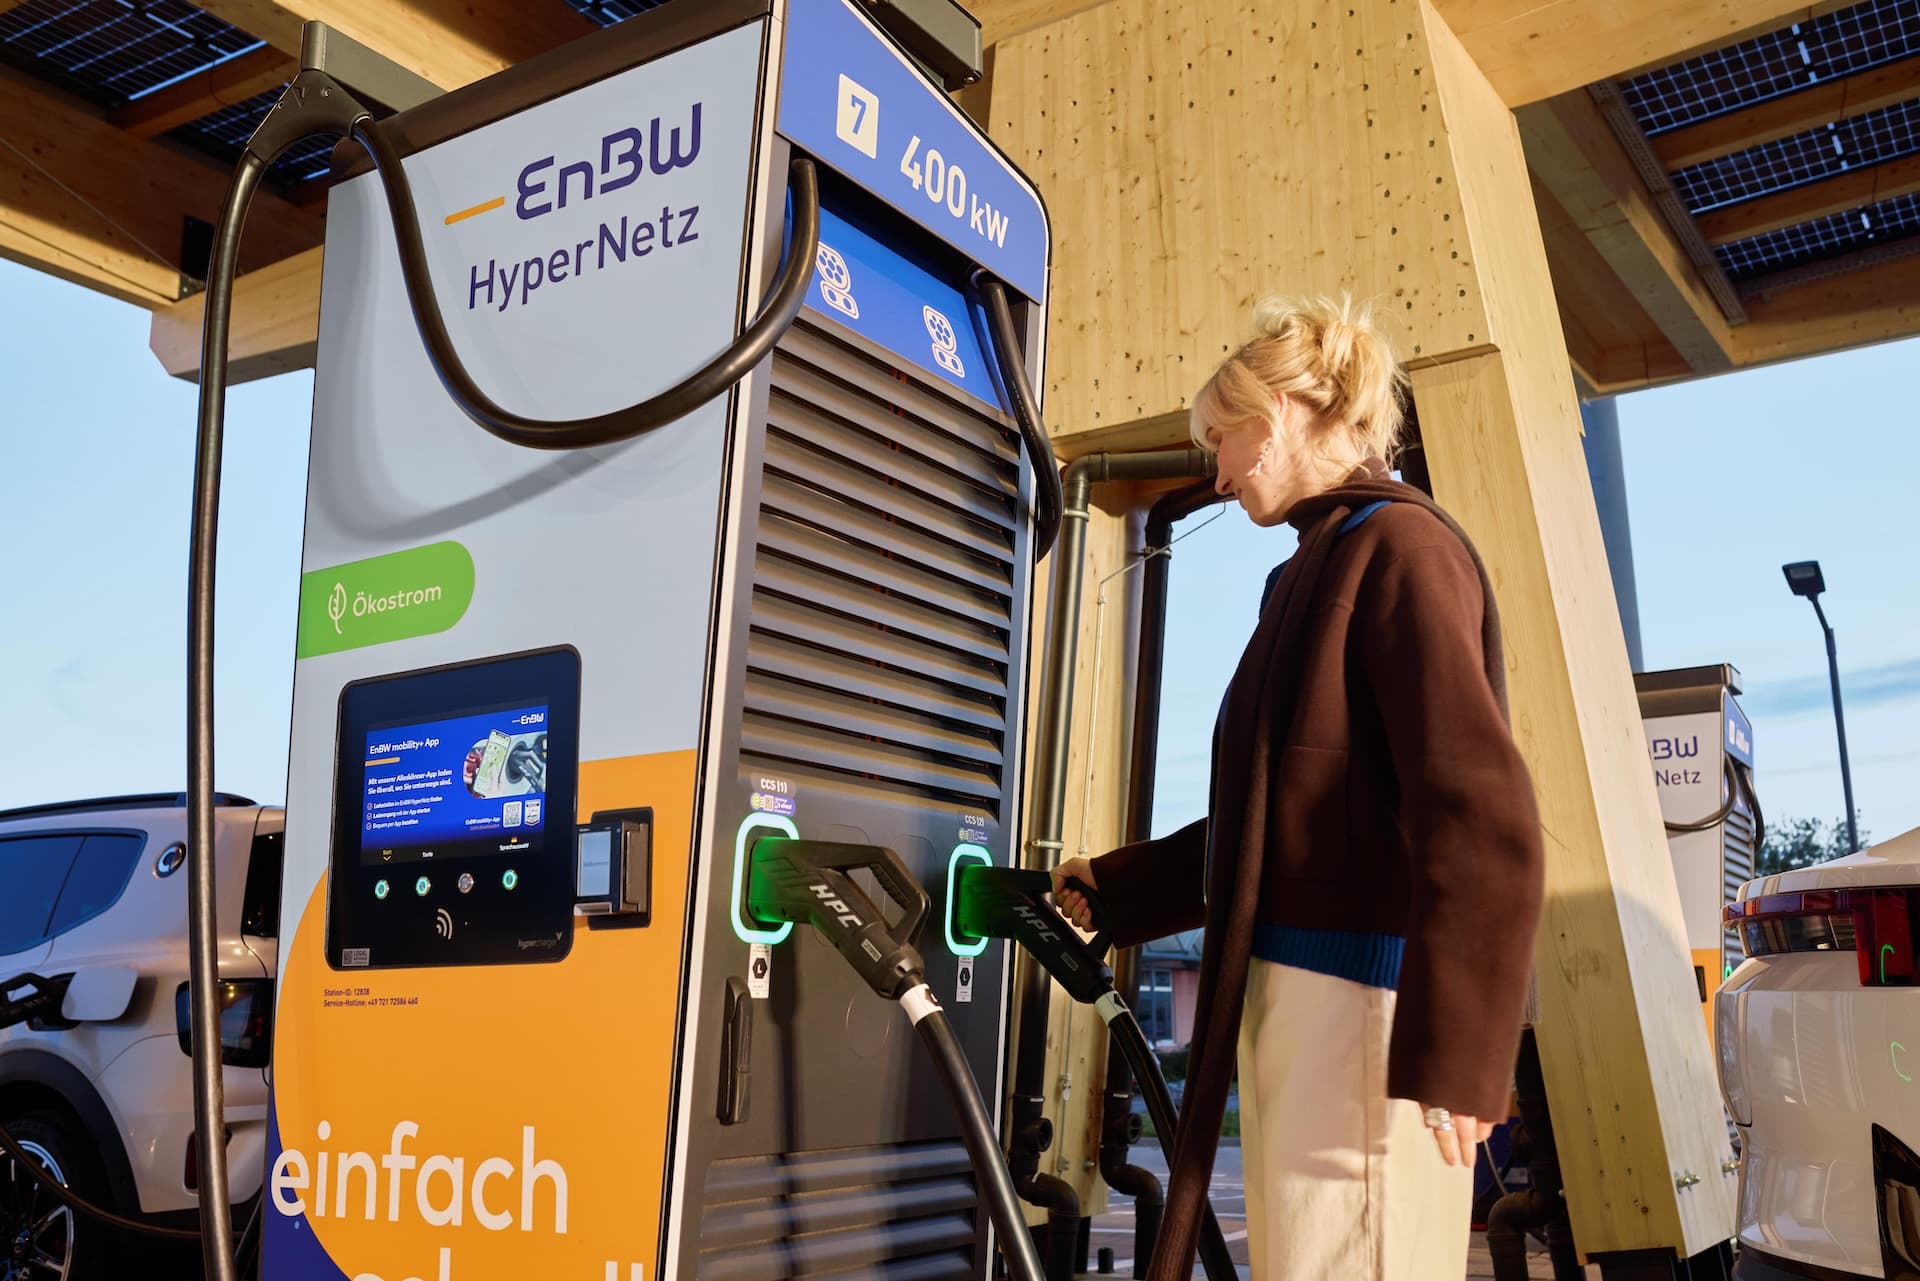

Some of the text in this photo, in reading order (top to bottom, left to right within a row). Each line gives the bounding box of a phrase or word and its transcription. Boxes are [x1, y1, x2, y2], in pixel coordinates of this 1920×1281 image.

[850, 94, 867, 136] 7
[516, 103, 701, 221] EnBW
[900, 135, 1009, 249] 400 kW
[468, 206, 700, 312] HyperNetz
[352, 584, 442, 617] Ökostrom
[520, 712, 545, 725] EnBW
[369, 737, 440, 755] EnBW mobility+ App
[1648, 736, 1698, 760] BW
[760, 778, 777, 791] CCS
[964, 815, 976, 825] CCS
[810, 884, 863, 928] HPC
[1013, 905, 1061, 943] HPC
[323, 988, 352, 997] Station-ID:
[270, 1120, 569, 1234] einfach
